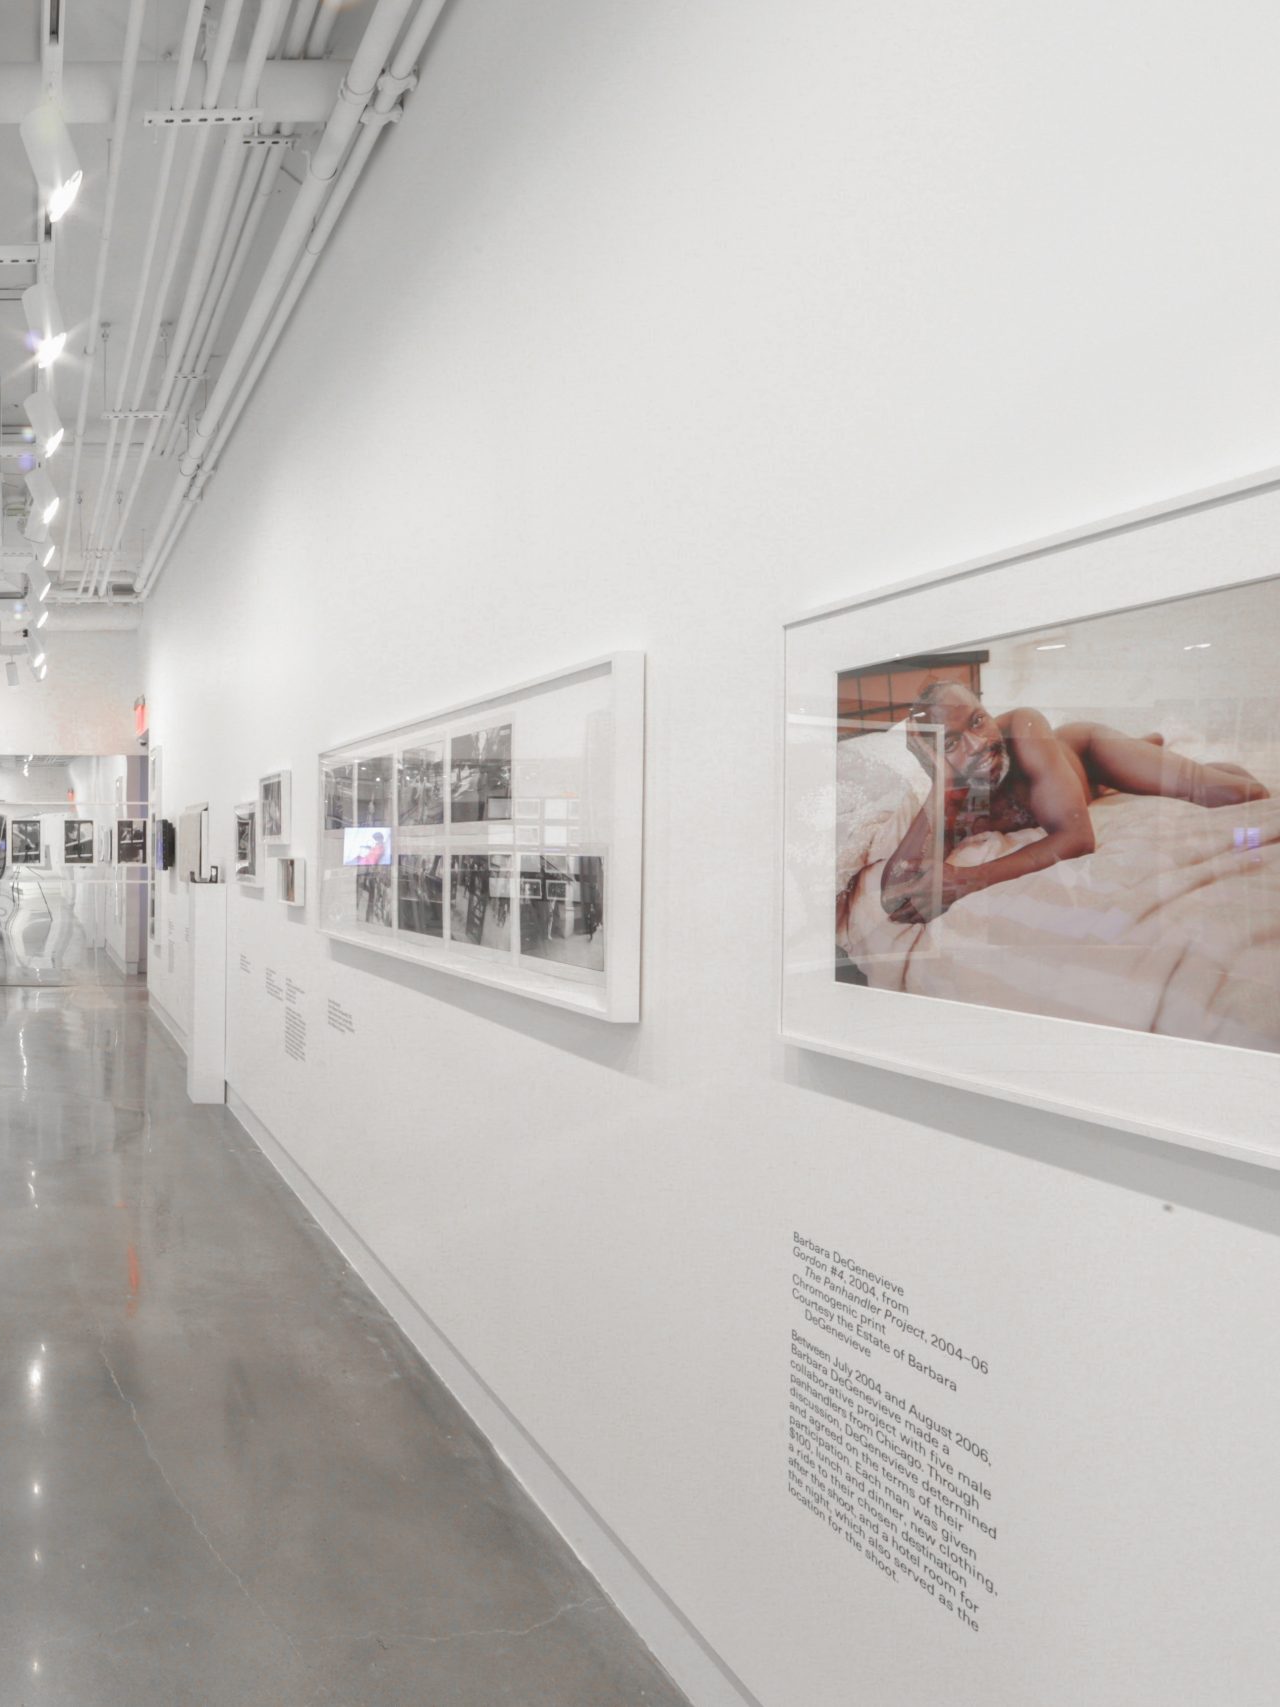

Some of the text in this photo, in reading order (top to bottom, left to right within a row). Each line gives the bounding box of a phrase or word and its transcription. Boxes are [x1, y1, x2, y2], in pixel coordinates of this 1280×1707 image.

[792, 1273, 885, 1336] Chromogenic print
[793, 1231, 904, 1298] Barbara DeGenevieve
[793, 1245, 909, 1316] Gordon #4, 2004, from
[805, 1266, 821, 1284] The
[823, 1275, 881, 1318] Panhandler
[884, 1308, 928, 1345] Project,
[791, 1329, 991, 1468] Between July 2004 and August 2006,
[791, 1343, 949, 1456] Barbara DeGenevieve made a
[792, 1287, 957, 1393] Courtesy the Estate of Barbara
[805, 1308, 871, 1358] DeGenevieve
[789, 1401, 963, 1534] and agreed on the terms of their
[789, 1415, 976, 1561] participation. Each man was given
[790, 1359, 991, 1501] collaborative project with five male
[790, 1373, 979, 1511] panhandlers from Chicago. Through
[790, 1384, 996, 1540] discussion, DeGenevieve determined
[788, 1443, 966, 1588] a ride to their chosen destination
[788, 1483, 898, 1583] location for the shoot.
[788, 1457, 978, 1615] after the shoot, and a hotel room for
[788, 1469, 979, 1632] the night, which also served as the
[789, 1427, 997, 1597] $100, lunch and dinner, new clothing,
